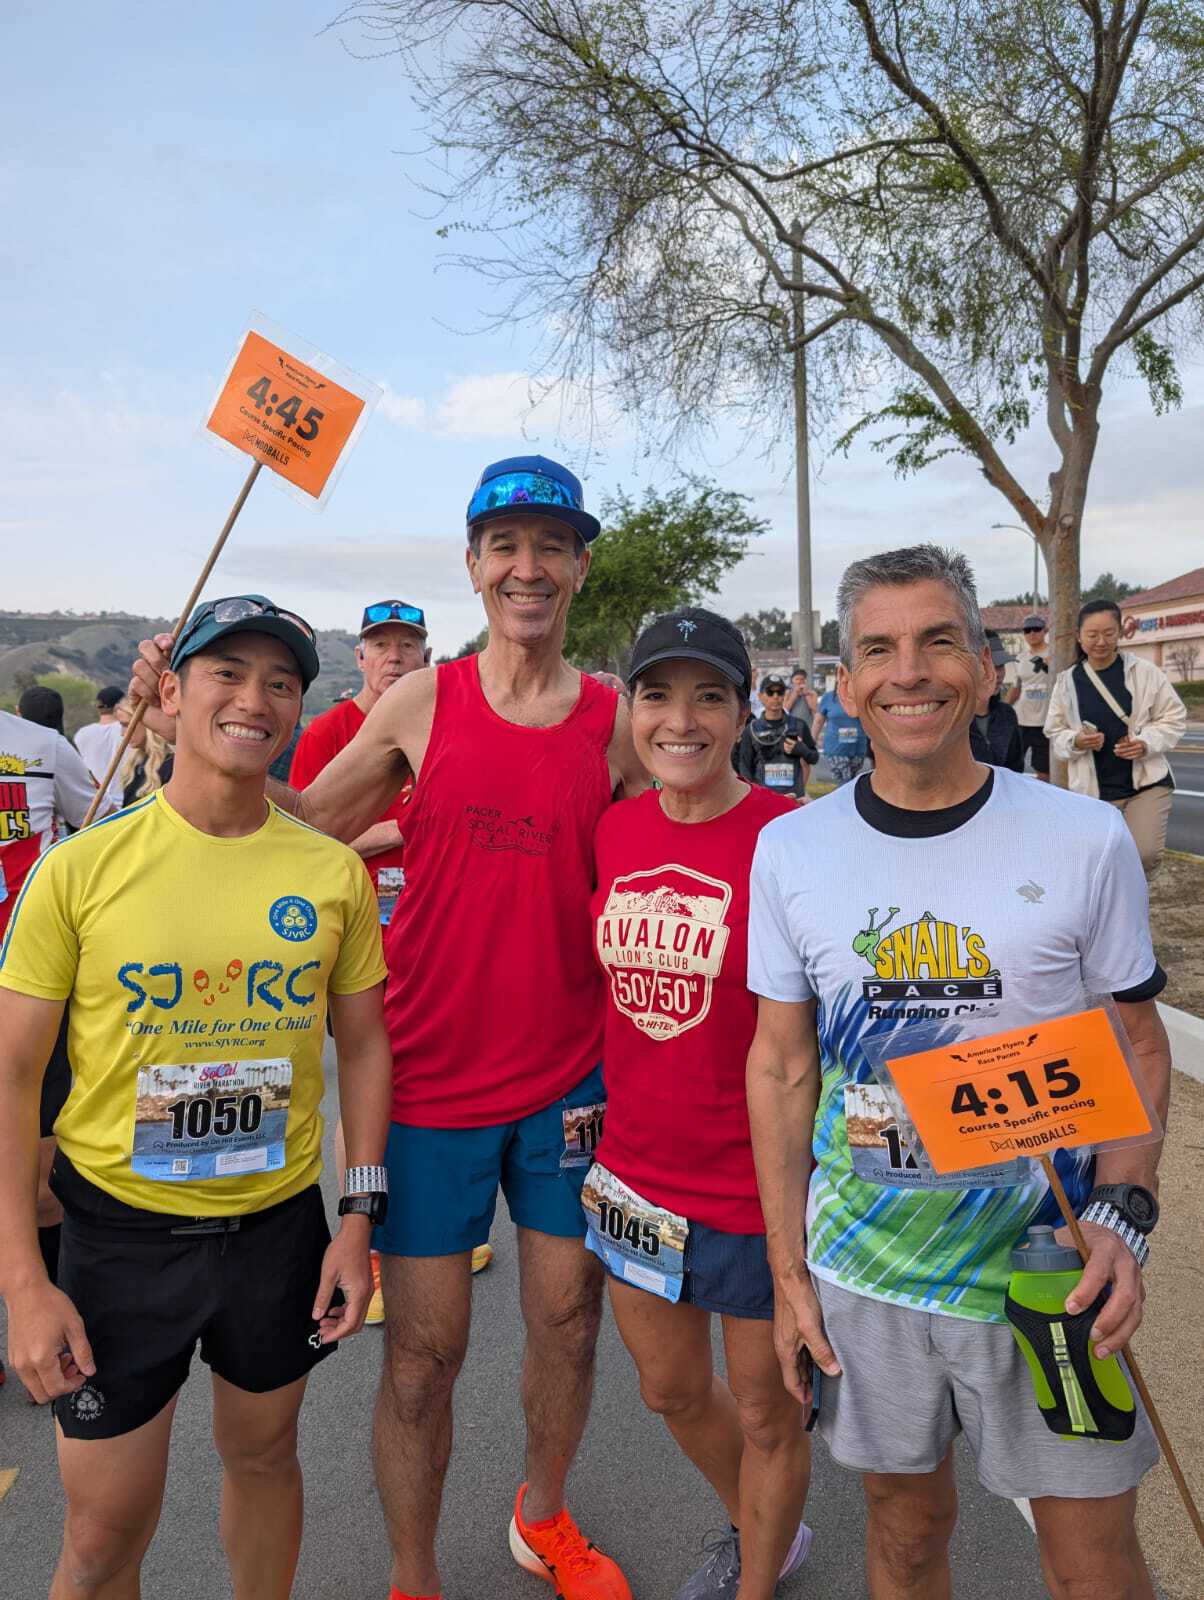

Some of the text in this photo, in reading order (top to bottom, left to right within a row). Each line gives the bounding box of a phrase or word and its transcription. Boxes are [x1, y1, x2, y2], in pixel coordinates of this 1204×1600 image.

[246, 376, 325, 441] 4:45
[239, 406, 312, 458] Course Specific Pacing
[282, 928, 311, 938] SJVRC
[602, 918, 715, 959] AVALON
[616, 950, 688, 970] LION'S CLUB
[875, 920, 991, 979] SNAIL'S
[868, 983, 997, 998] PACE
[868, 1005, 949, 1020] Running
[169, 1019, 208, 1035] Mile
[208, 1018, 235, 1036] for
[240, 1017, 271, 1032] One
[184, 1038, 266, 1049] www.SJVRC.org
[968, 1040, 1024, 1058] American Flyers
[997, 1051, 1020, 1061] Pacers
[199, 1062, 238, 1081] SoCal
[950, 1057, 1081, 1117] 4:15
[167, 1093, 262, 1140] 1050
[959, 1098, 1095, 1134] Course Specific Pacing
[1016, 1123, 1077, 1149] MODBALLS
[598, 1202, 660, 1256] 1045
